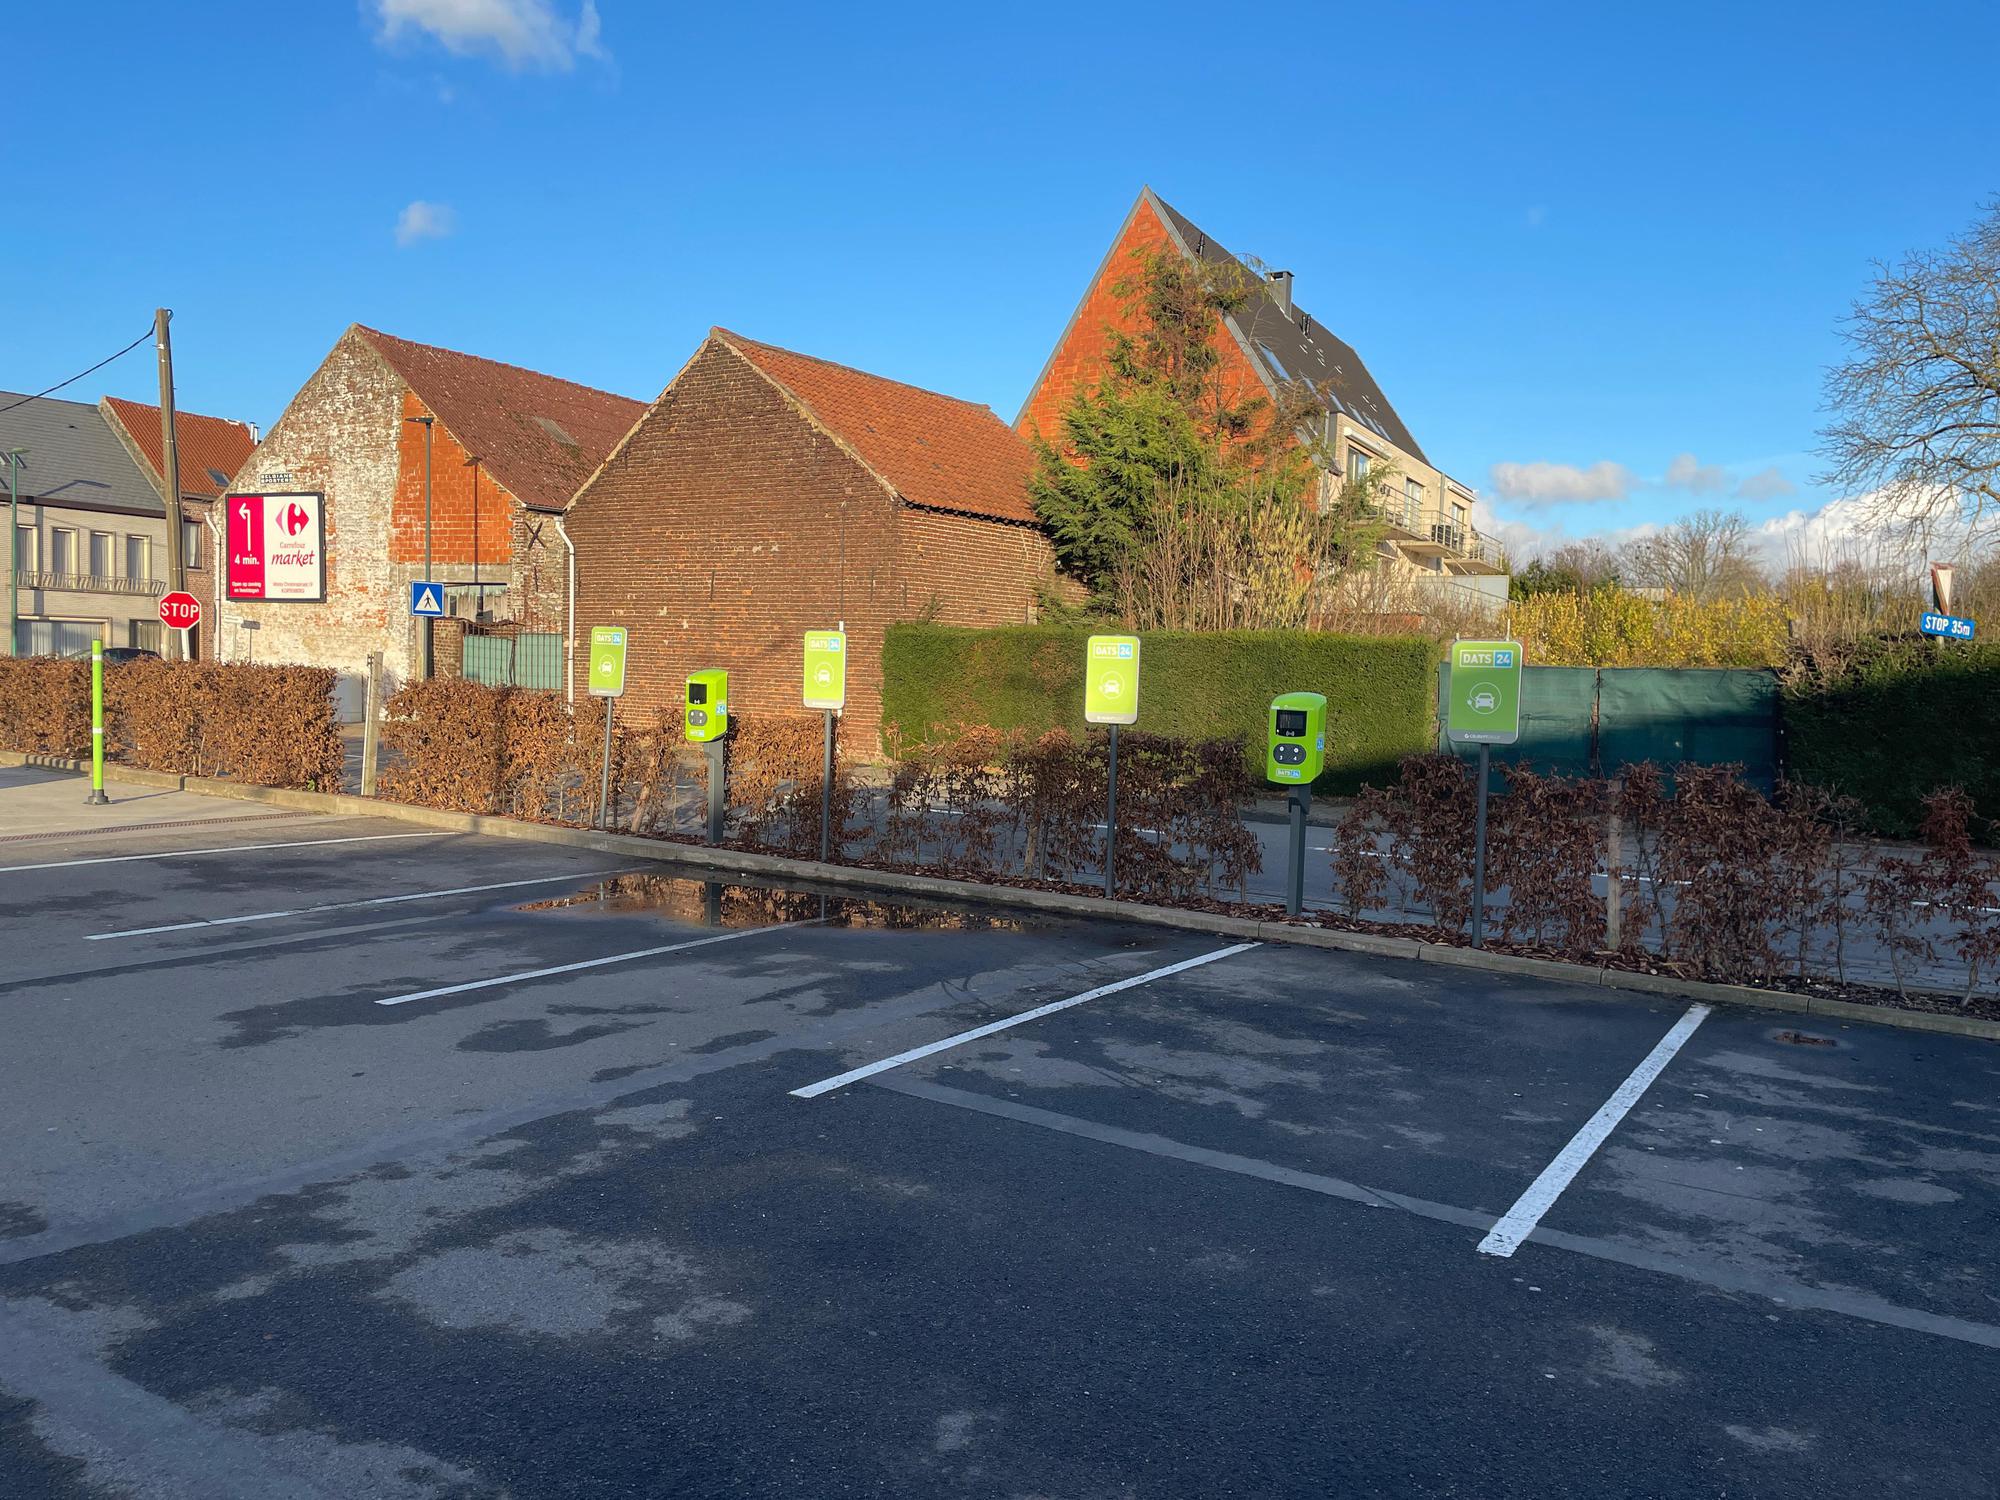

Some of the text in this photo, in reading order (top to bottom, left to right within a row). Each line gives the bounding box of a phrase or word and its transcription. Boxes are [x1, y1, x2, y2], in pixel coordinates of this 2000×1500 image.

[234, 553, 260, 565] 4 min.
[271, 550, 315, 567] market
[161, 602, 199, 618] STOP
[1925, 615, 1949, 632] STOP
[1096, 646, 1131, 656] DATS 24
[1463, 653, 1510, 665] DATS 24
